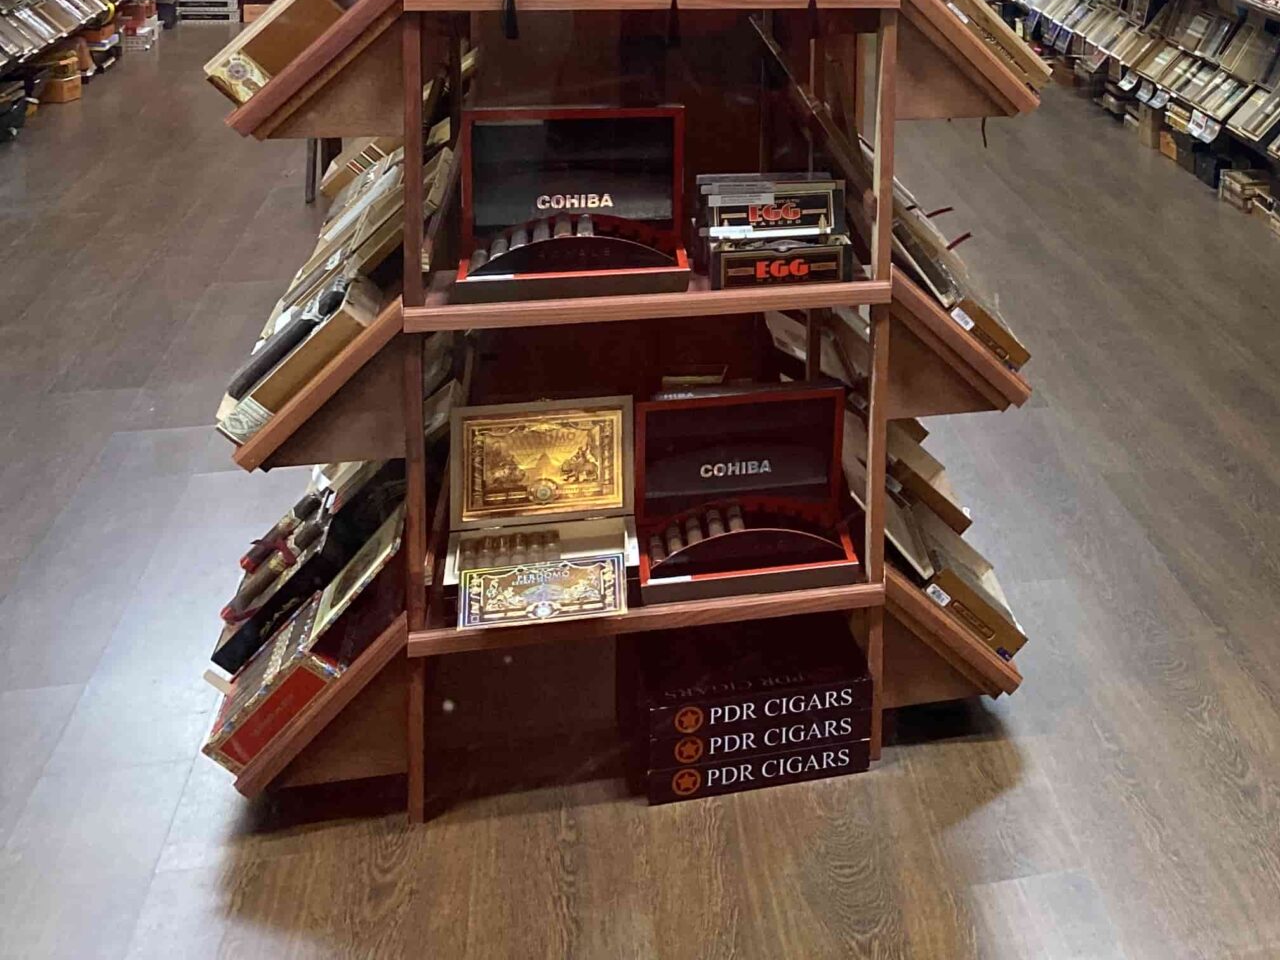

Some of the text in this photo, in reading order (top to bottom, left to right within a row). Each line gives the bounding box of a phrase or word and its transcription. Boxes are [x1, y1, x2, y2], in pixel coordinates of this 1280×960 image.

[536, 193, 614, 209] COHIBA
[749, 203, 800, 222] EGG
[756, 259, 809, 279] EGG
[700, 460, 771, 478] COHIBA
[517, 570, 570, 583] PERDOMO
[709, 688, 853, 725] PDR CIGARS
[709, 718, 852, 755] PDR CIGARS
[707, 748, 850, 787] PDR CIGARS
